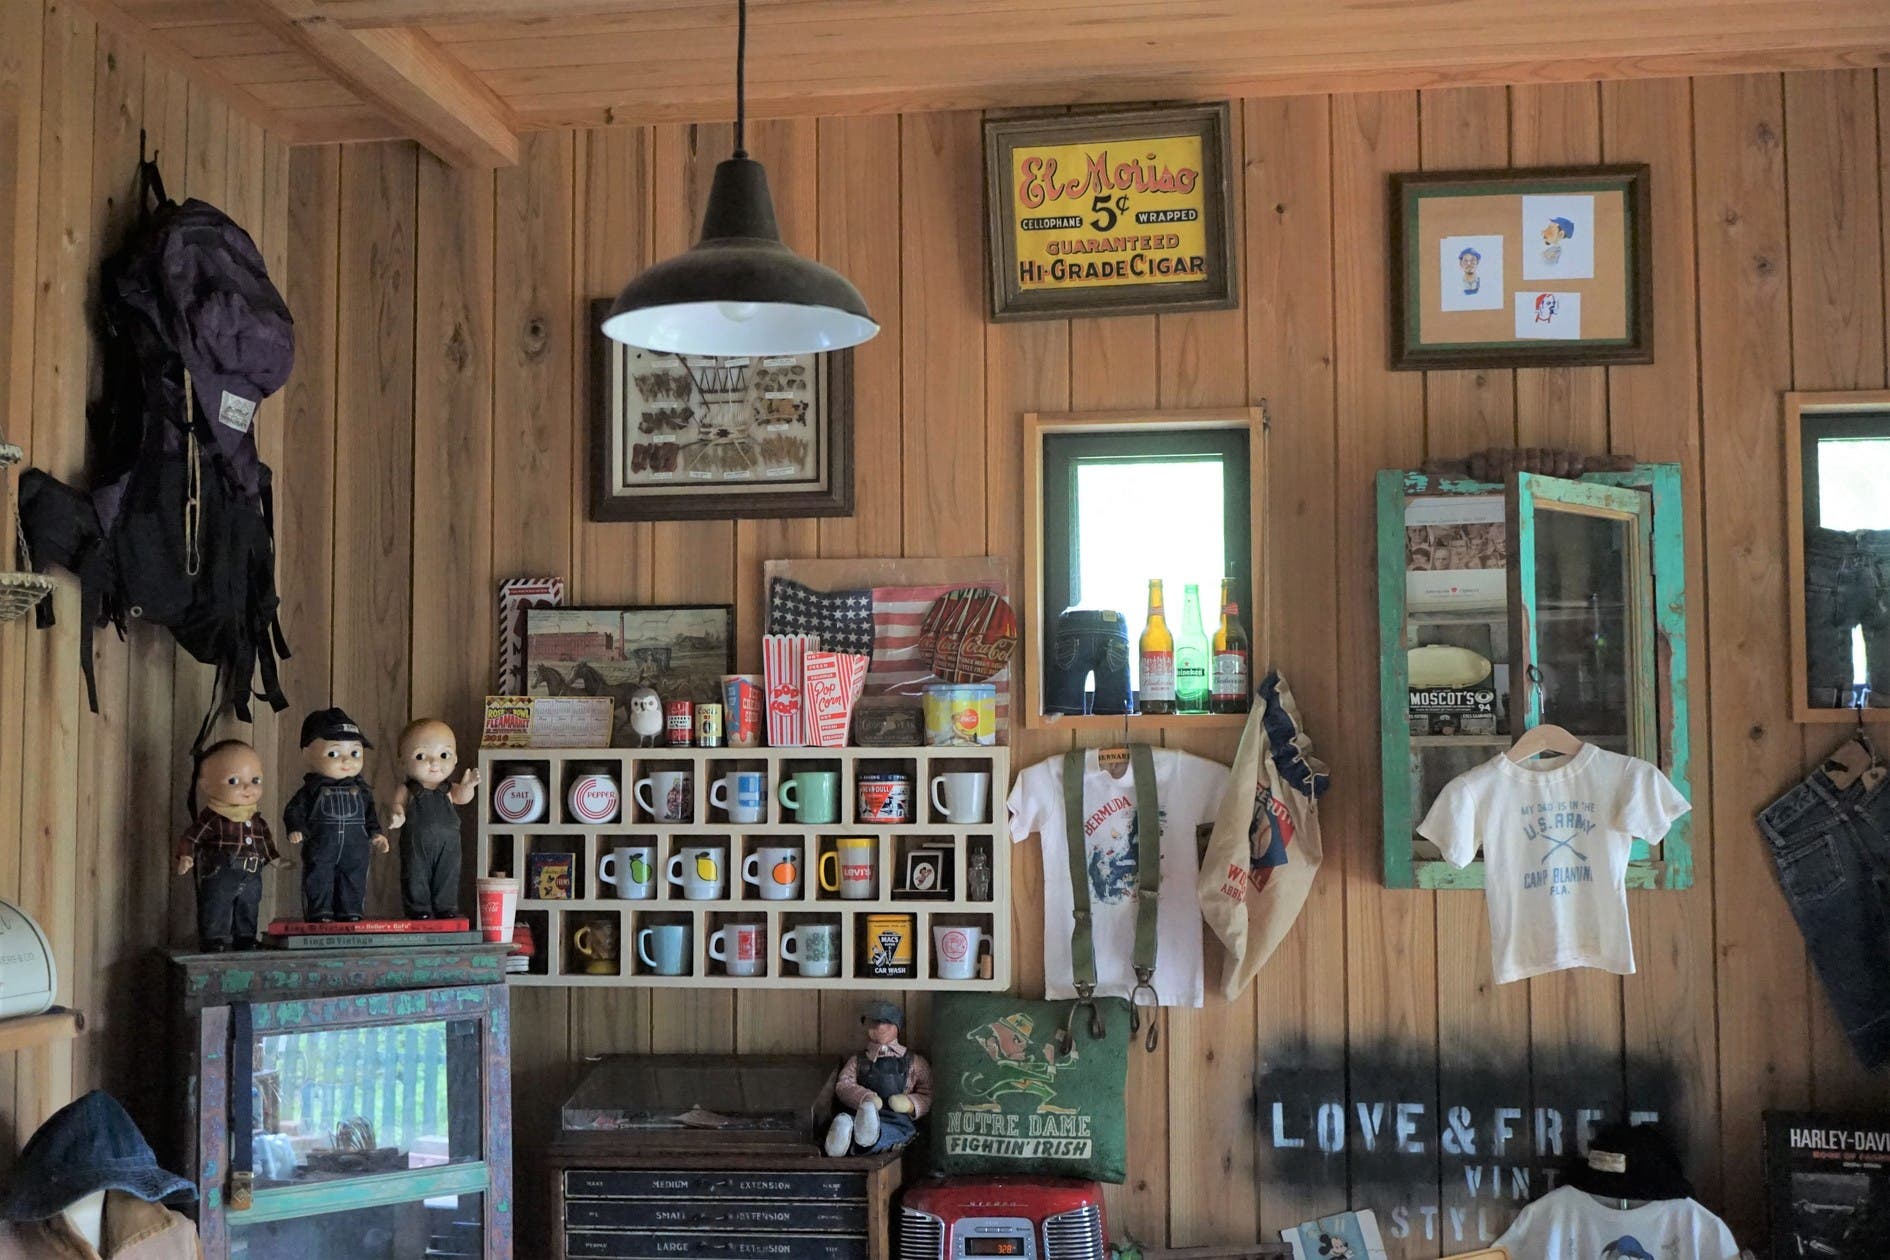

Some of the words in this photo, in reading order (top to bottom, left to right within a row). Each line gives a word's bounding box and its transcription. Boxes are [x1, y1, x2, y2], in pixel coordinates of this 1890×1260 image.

[1020, 156, 1065, 208] El
[1065, 151, 1199, 198] Moriso
[1022, 216, 1082, 230] CELLOPHANE
[1138, 210, 1197, 223] WRAPPED
[1045, 234, 1180, 255] GUARANTEED
[1130, 254, 1207, 277] CIGAR
[1410, 691, 1474, 705] MOSCOT'S
[1478, 704, 1491, 712] 94
[511, 791, 529, 799] SALT
[587, 791, 616, 799] PEPPER
[1084, 795, 1132, 838] BERMUDA
[1523, 869, 1548, 889] CAMP
[947, 1112, 1020, 1137] NOTRE
[1029, 1115, 1091, 1137] DAME
[950, 1137, 1030, 1156] FIGHTIN'
[1033, 1140, 1088, 1157] IRISH
[652, 1181, 688, 1189] MEDIUM
[657, 1242, 688, 1251] LARGE
